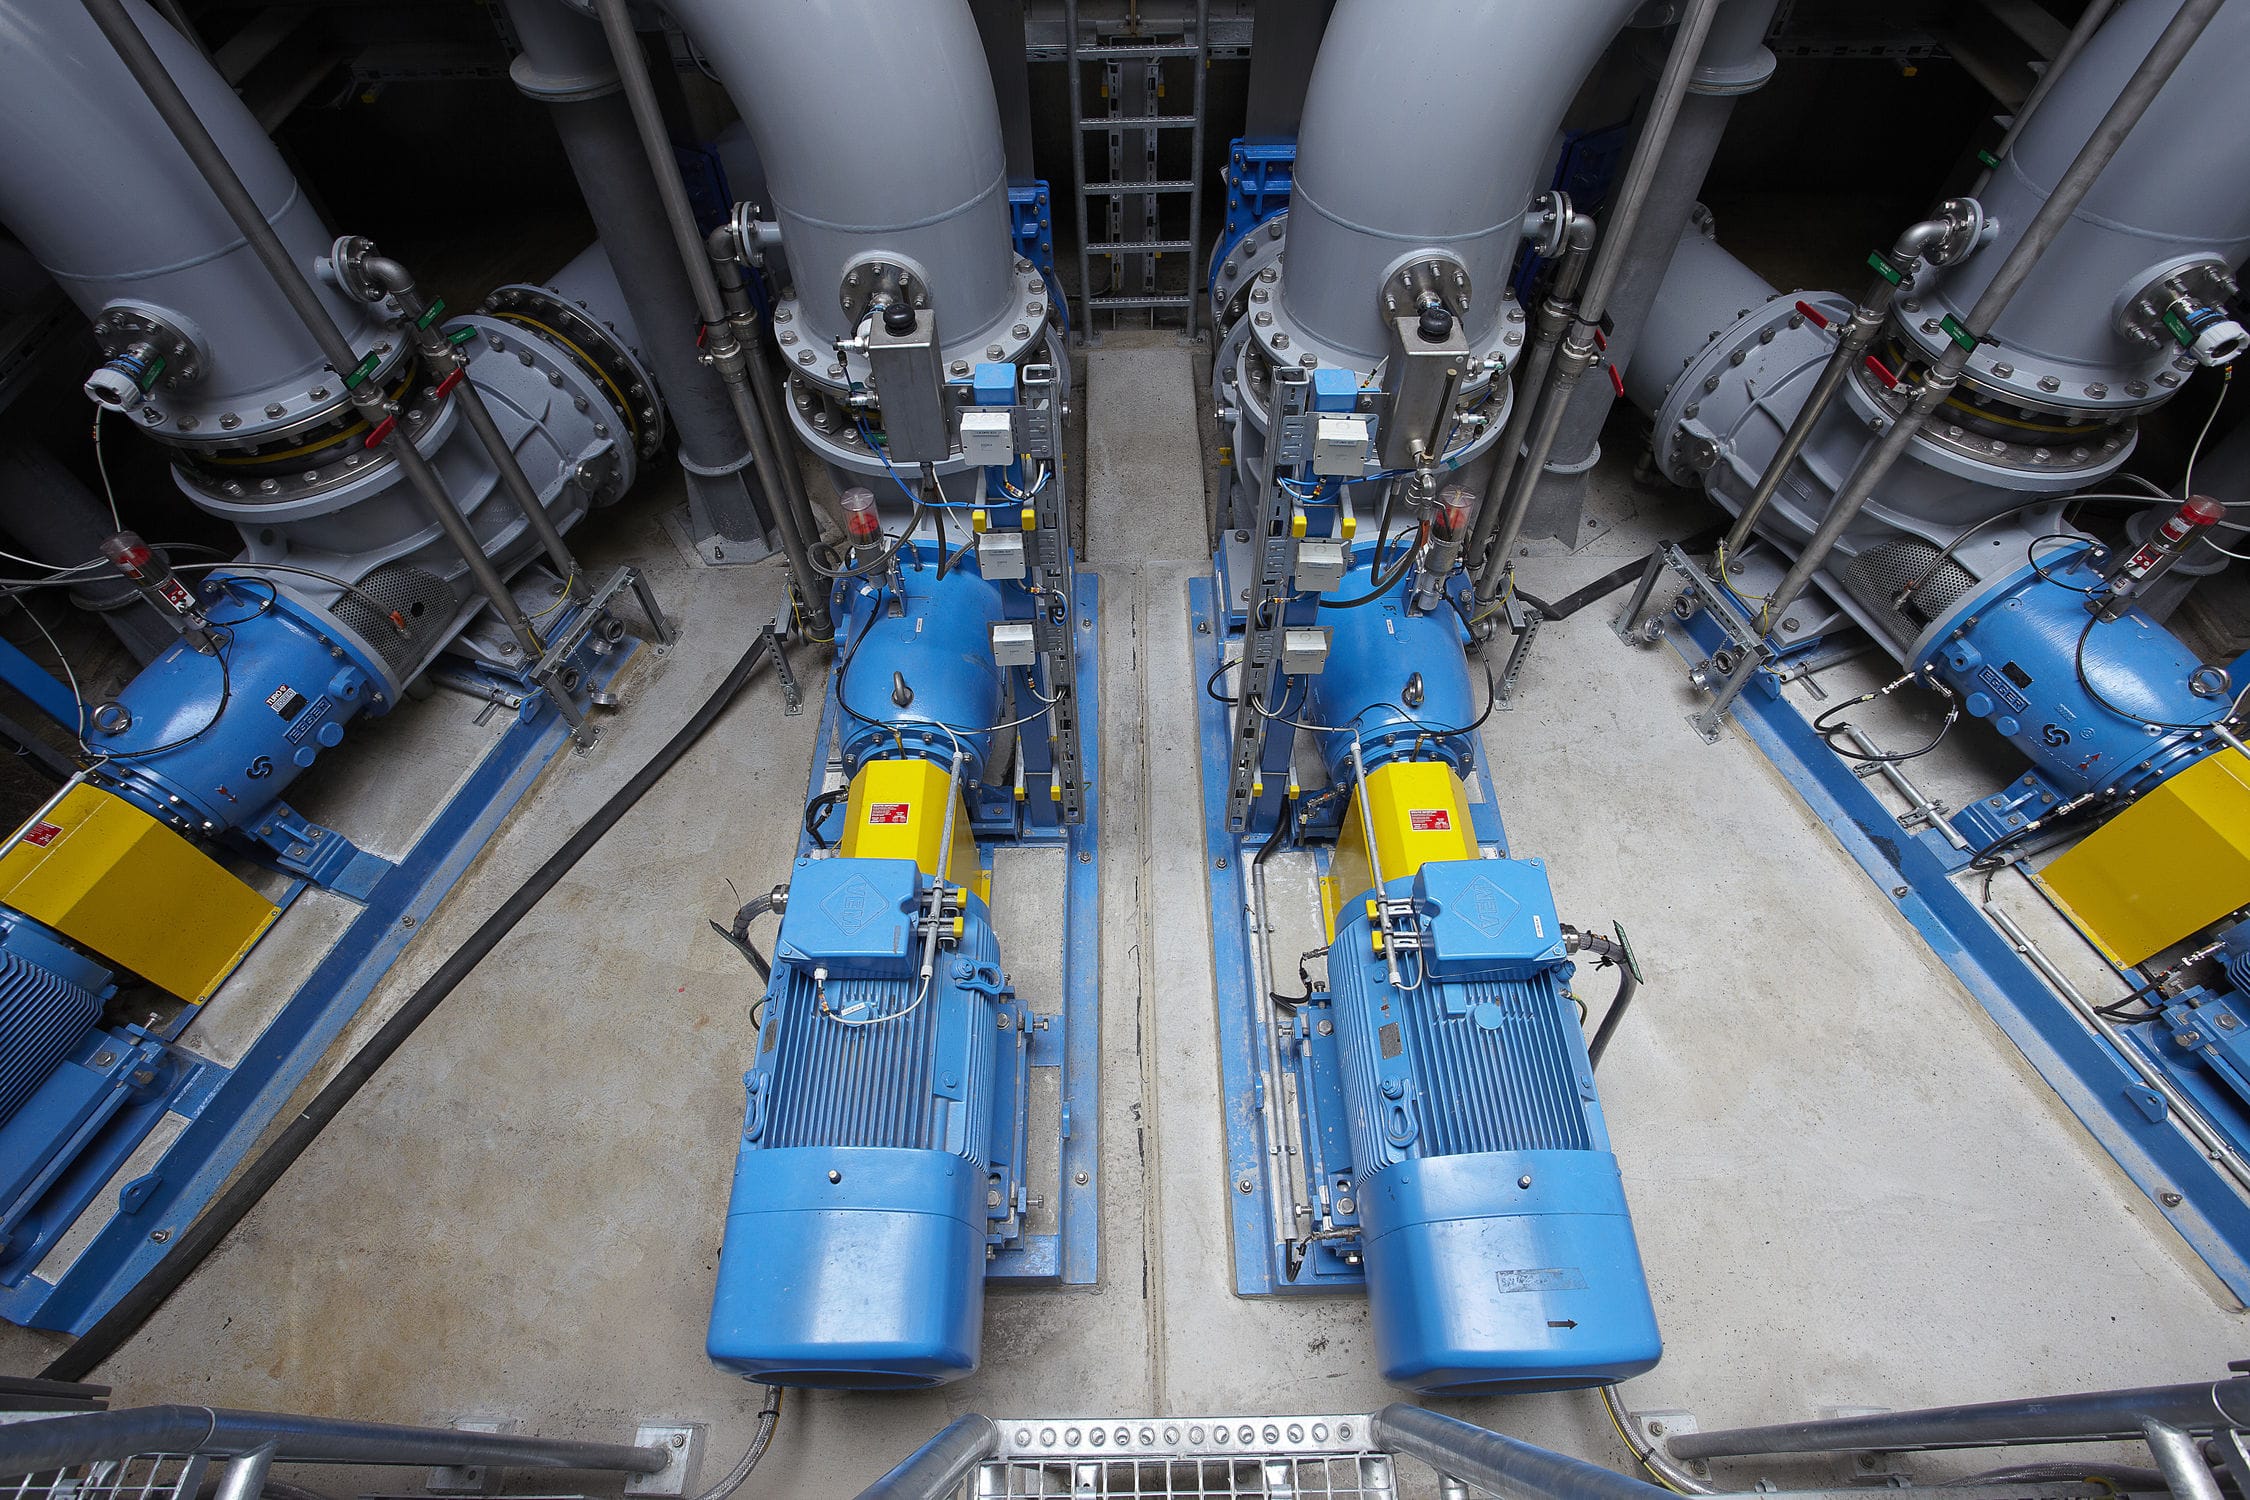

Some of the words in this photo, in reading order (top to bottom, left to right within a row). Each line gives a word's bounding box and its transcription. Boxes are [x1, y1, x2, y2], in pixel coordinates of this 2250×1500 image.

[265, 689, 283, 705] TURO
[1984, 669, 2024, 708] EGGER
[289, 701, 326, 739] EGGER
[841, 882, 867, 928] VEM
[1472, 883, 1500, 930] VEM
